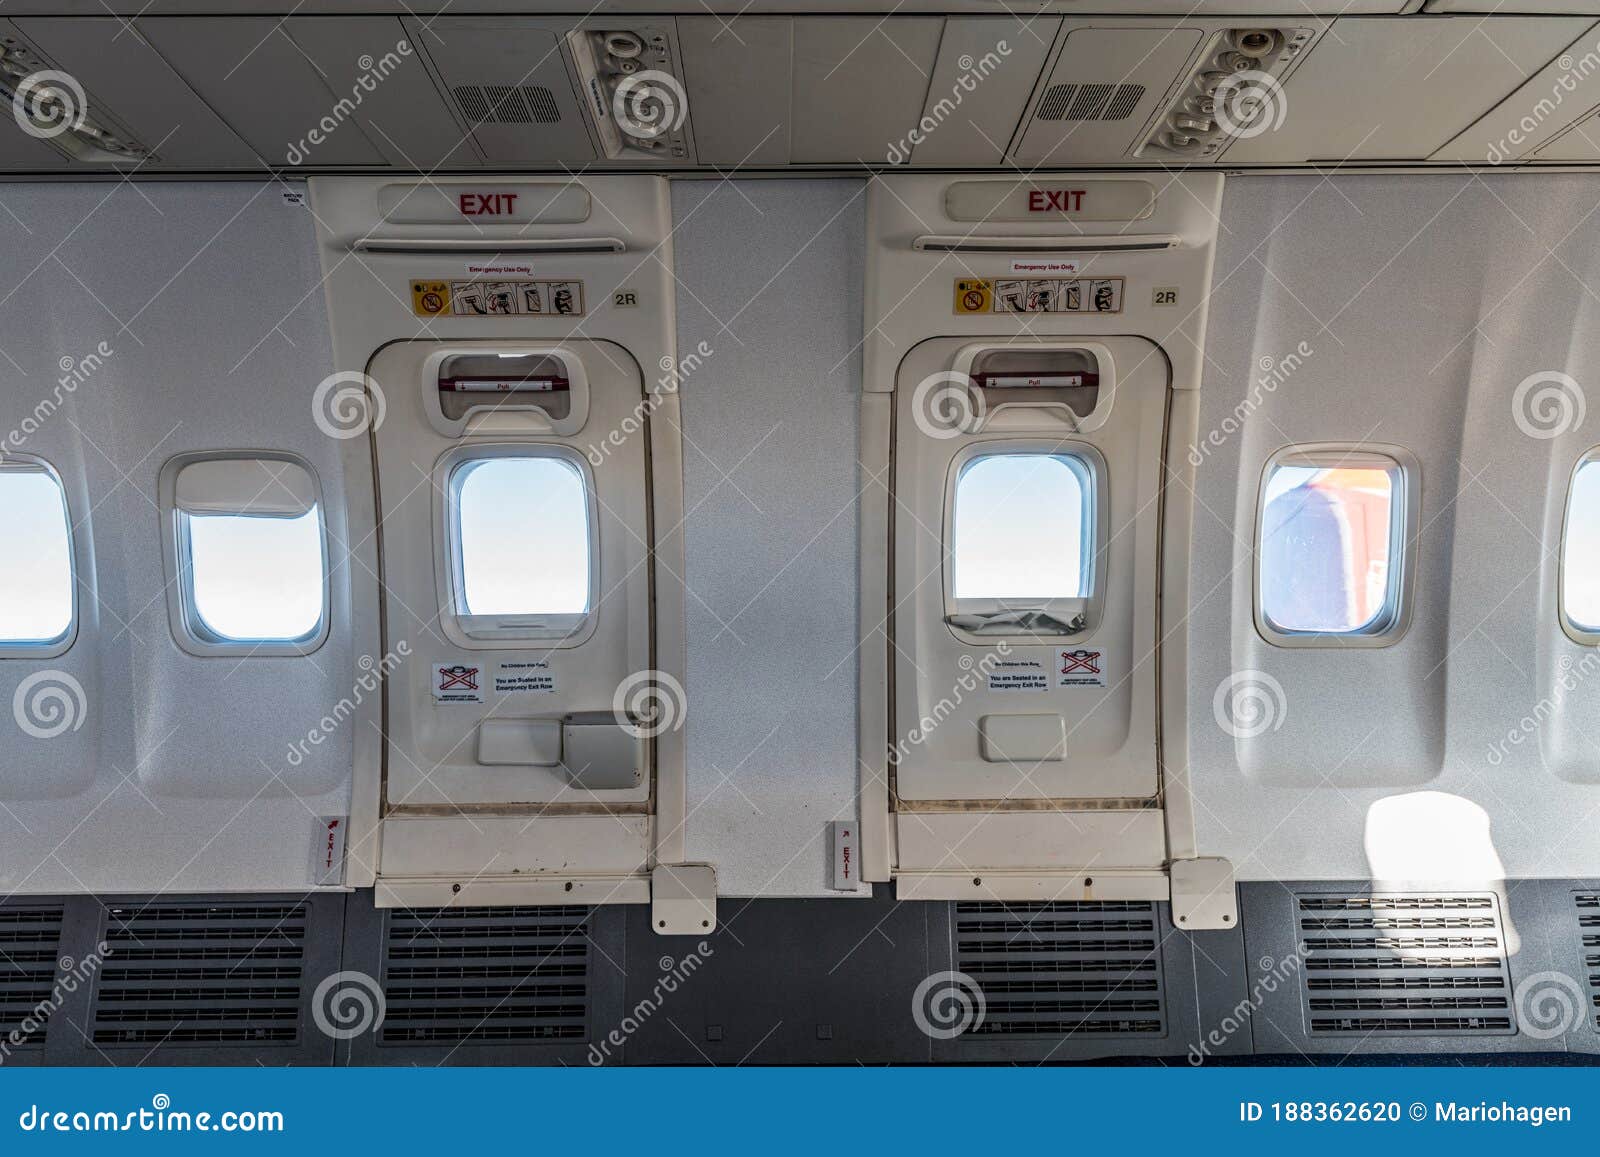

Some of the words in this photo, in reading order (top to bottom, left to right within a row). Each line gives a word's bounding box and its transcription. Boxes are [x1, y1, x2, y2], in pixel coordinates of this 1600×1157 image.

[459, 194, 518, 215] EXIT
[1028, 190, 1087, 212] EXIT
[469, 266, 503, 274] Emergency
[516, 266, 531, 274] Only
[1014, 263, 1047, 272] Emergency
[1048, 263, 1060, 271] Use
[1060, 263, 1076, 272] Only
[615, 293, 637, 306] 2R
[1155, 291, 1177, 304] 2R
[1028, 378, 1041, 386] Pull
[326, 833, 335, 868] EXIT
